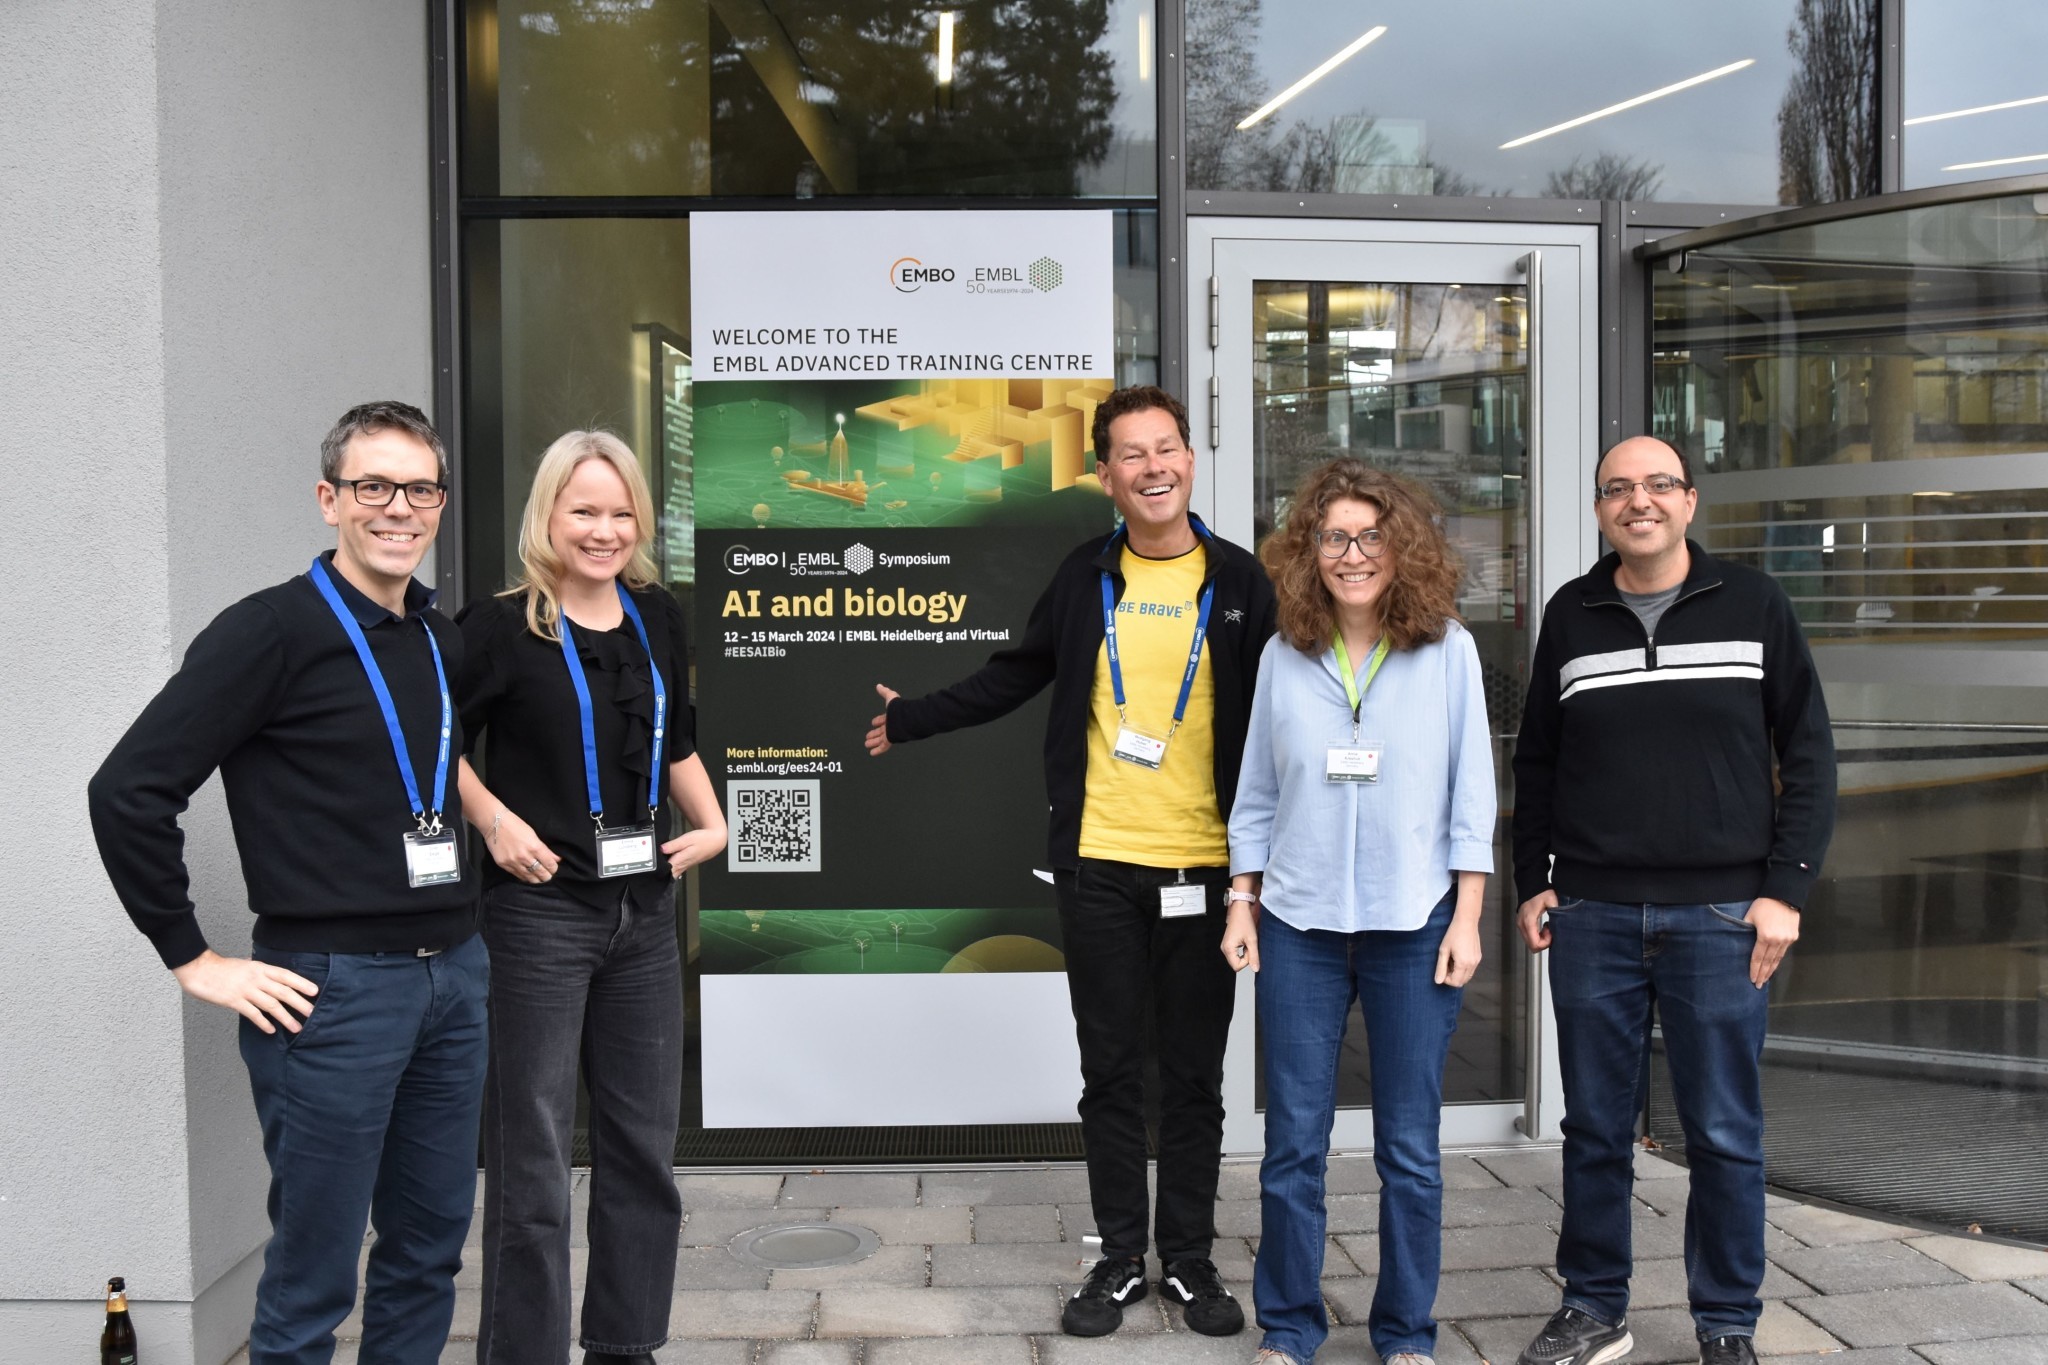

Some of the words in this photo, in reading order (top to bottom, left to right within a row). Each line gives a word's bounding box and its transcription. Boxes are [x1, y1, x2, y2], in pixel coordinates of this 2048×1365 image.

[903, 268, 955, 283] EMBO
[976, 268, 1023, 281] EMBL
[967, 279, 985, 294] 50
[713, 328, 815, 346] WELCOME
[824, 328, 850, 345] TO
[857, 328, 897, 345] THE
[714, 355, 768, 373] EMBL
[776, 354, 889, 372] ADVANCED
[897, 354, 1003, 371] TRAINING
[1011, 354, 1092, 371] CENTRE
[734, 552, 778, 567] EMBO
[799, 553, 840, 565] EMBL
[879, 552, 950, 568] Symposium
[790, 562, 807, 575] 50
[722, 590, 760, 617] AI
[771, 588, 833, 617] and
[845, 588, 967, 623] biology
[1118, 602, 1135, 613] BE
[724, 631, 738, 643] 12
[752, 631, 765, 643] 15
[769, 630, 803, 643] March
[807, 630, 835, 642] 2024
[846, 630, 877, 642] EMBL
[881, 629, 943, 644] Heidelberg
[946, 628, 967, 641] and
[970, 628, 1009, 641] Virtual
[725, 645, 786, 658] #EESAIBio
[727, 747, 755, 759] More
[758, 746, 827, 758] information:
[726, 761, 843, 776] s.embl.org/ees24-01
